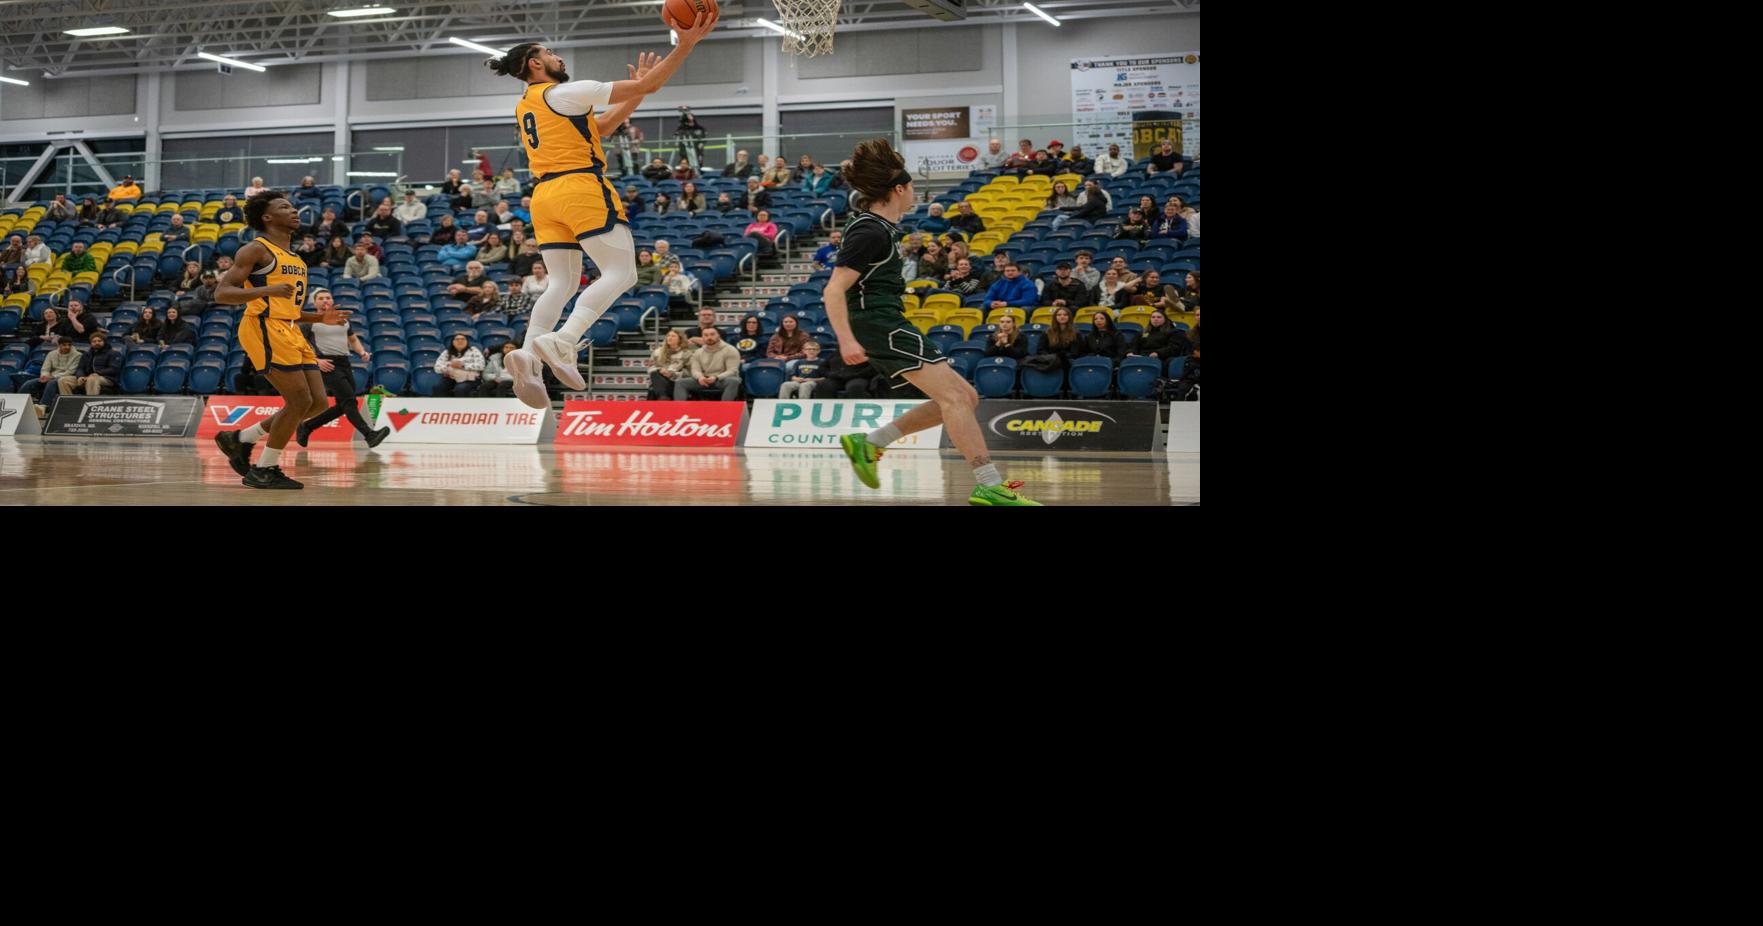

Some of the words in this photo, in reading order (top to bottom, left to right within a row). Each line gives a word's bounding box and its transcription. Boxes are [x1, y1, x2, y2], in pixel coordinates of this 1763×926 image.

[523, 112, 540, 149] 9
[281, 265, 305, 276] BOBCA
[295, 280, 304, 305] 2
[126, 405, 156, 413] STEEL
[421, 412, 499, 425] CANADIAN
[505, 413, 537, 425] TIRE
[563, 410, 615, 436] Tim
[617, 410, 732, 438] Hortons
[1006, 419, 1103, 432] CANCADE
[768, 434, 843, 444] COUNT
